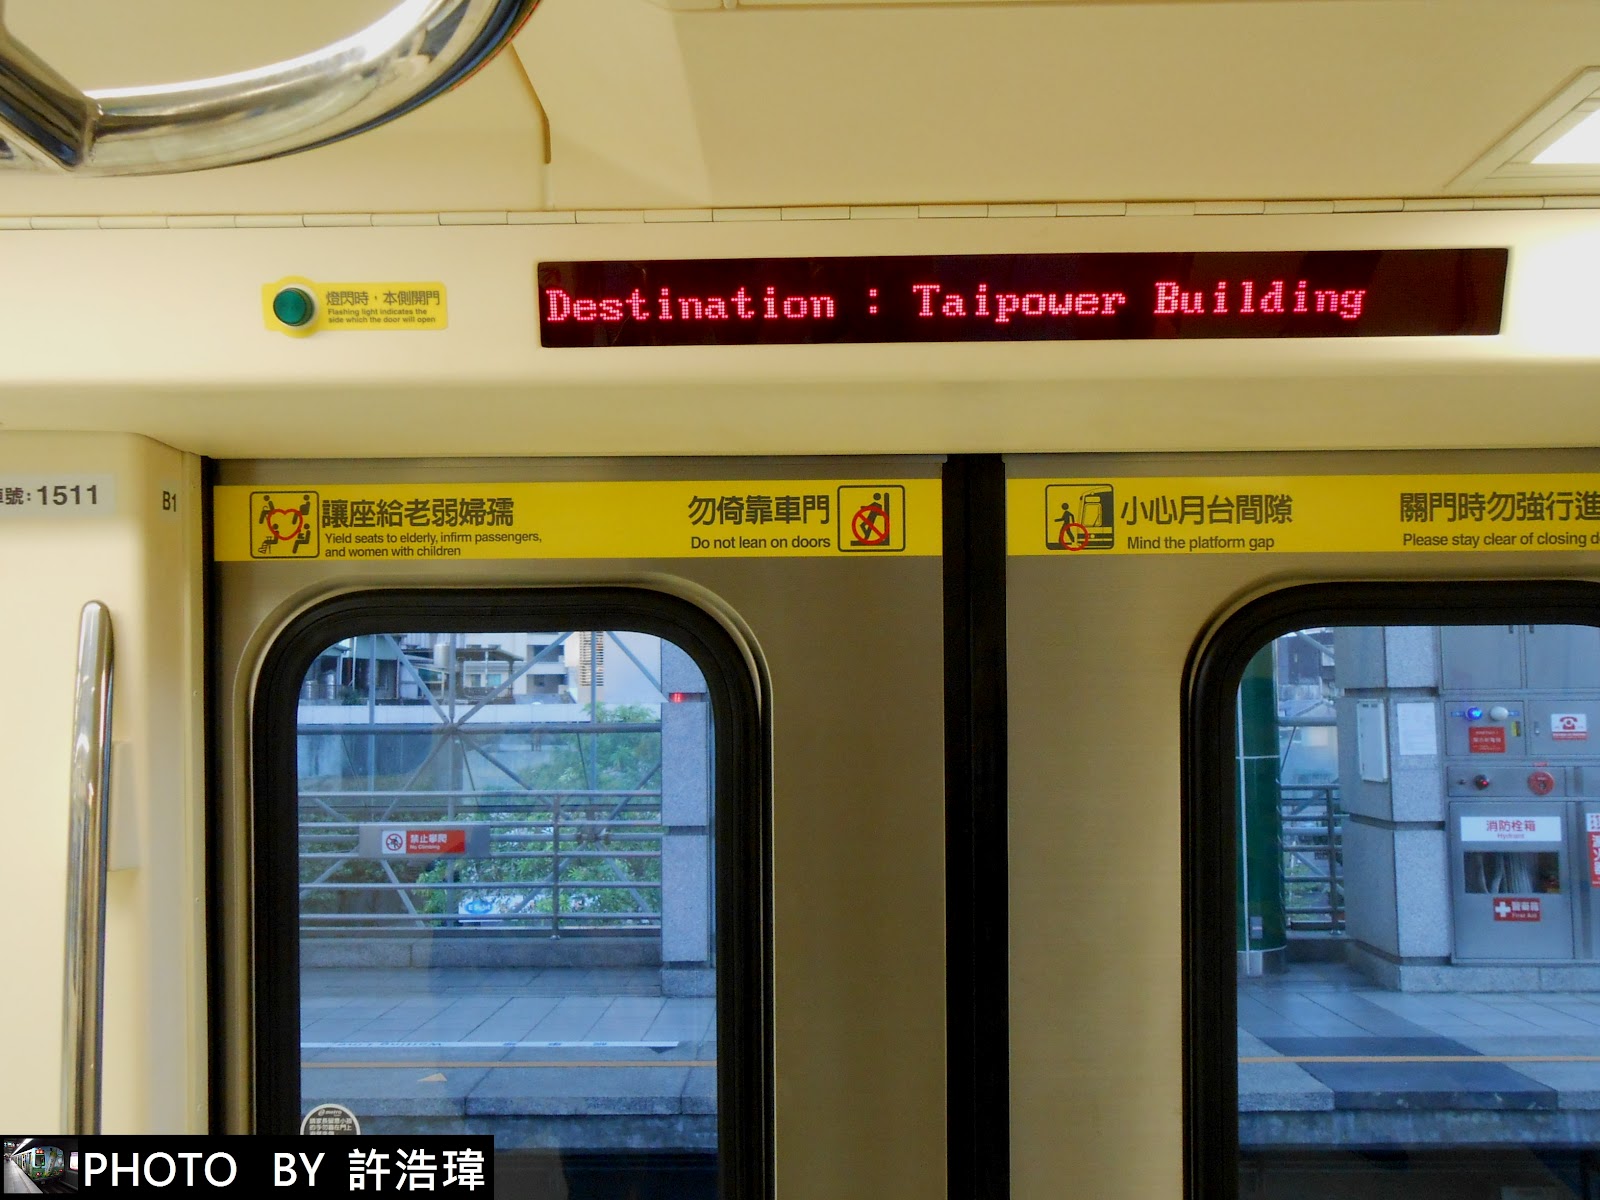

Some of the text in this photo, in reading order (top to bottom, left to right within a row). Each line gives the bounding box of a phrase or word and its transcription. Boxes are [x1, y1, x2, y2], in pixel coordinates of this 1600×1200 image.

[545, 286, 836, 322] Destination
[911, 283, 1127, 323] Taipower
[1153, 279, 1368, 319] Building
[328, 308, 360, 317] Flashing
[361, 308, 378, 317] light
[380, 308, 414, 316] indicates
[328, 316, 344, 324] side
[346, 316, 367, 324] which
[369, 316, 382, 324] the
[417, 316, 436, 324] open
[162, 490, 178, 512] B1
[321, 497, 515, 529] 讓座給老弱婦孺
[687, 494, 830, 526] 勿倚靠車門
[1120, 494, 1294, 526] 小心月台間隙
[325, 531, 542, 546] Yield seats to elderly, infirm passengers,
[691, 535, 831, 549] Do not lean on doors
[1127, 535, 1275, 551] Mind the platform gap
[1402, 533, 1449, 546] Please
[1452, 534, 1480, 549] stay
[1483, 532, 1517, 546] clear
[1519, 532, 1534, 545] of
[1537, 532, 1587, 548] closing
[325, 545, 461, 558] and women with children
[1486, 819, 1536, 832] 消防栓箱
